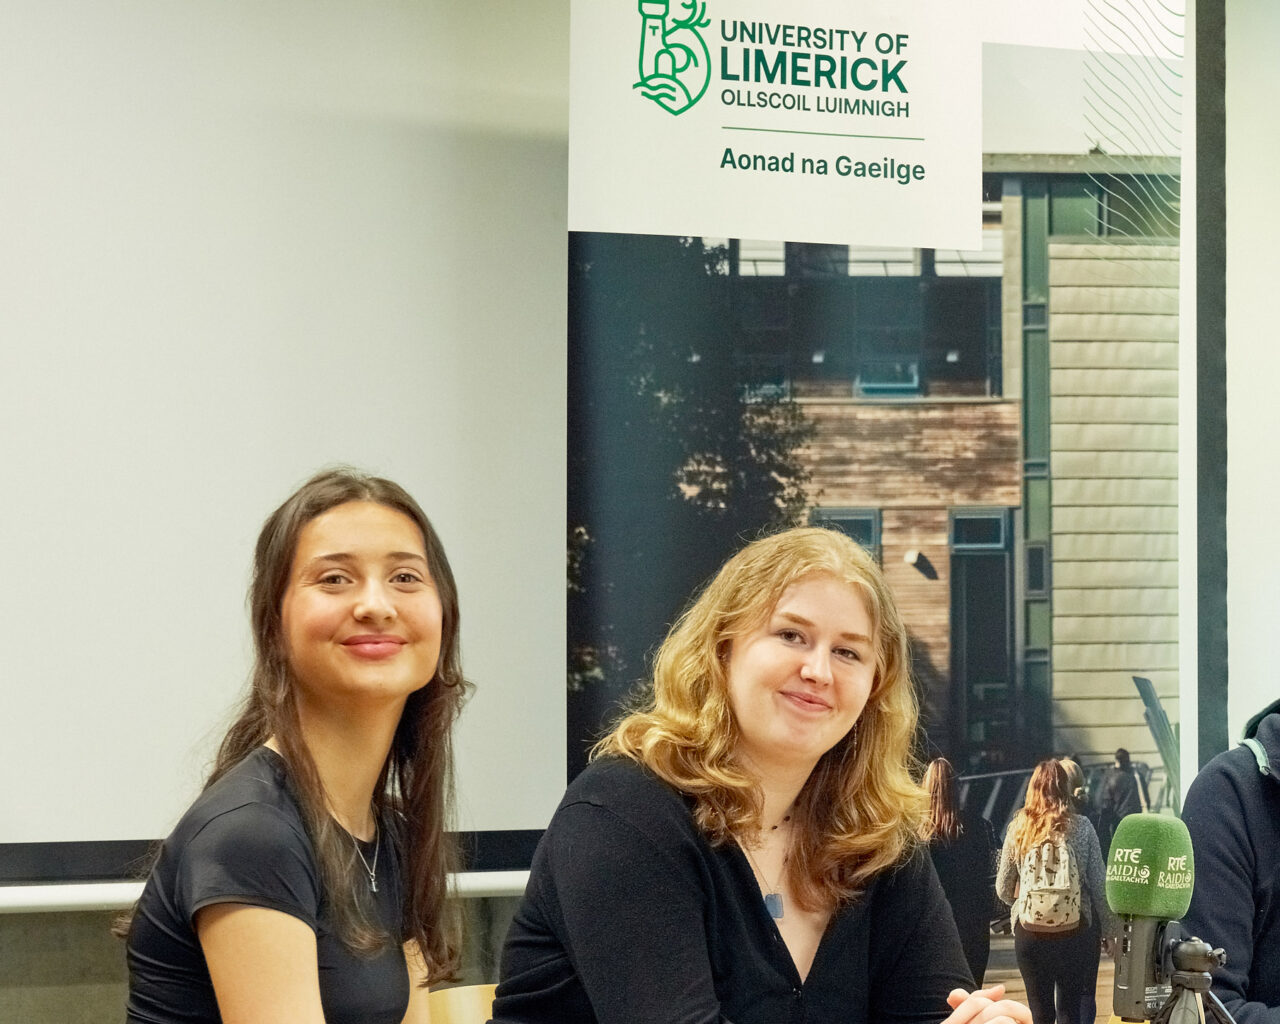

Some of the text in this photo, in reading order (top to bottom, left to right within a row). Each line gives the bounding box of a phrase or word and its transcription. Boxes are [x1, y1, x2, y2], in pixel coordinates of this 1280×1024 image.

[720, 19, 909, 55] UNIVERSITY OF
[720, 46, 909, 94] LIMERICK
[720, 88, 910, 118] OLLSCOIL LUIMNIGH
[720, 147, 926, 185] Aonad na Gaeilge
[1114, 848, 1142, 864] RTÉ
